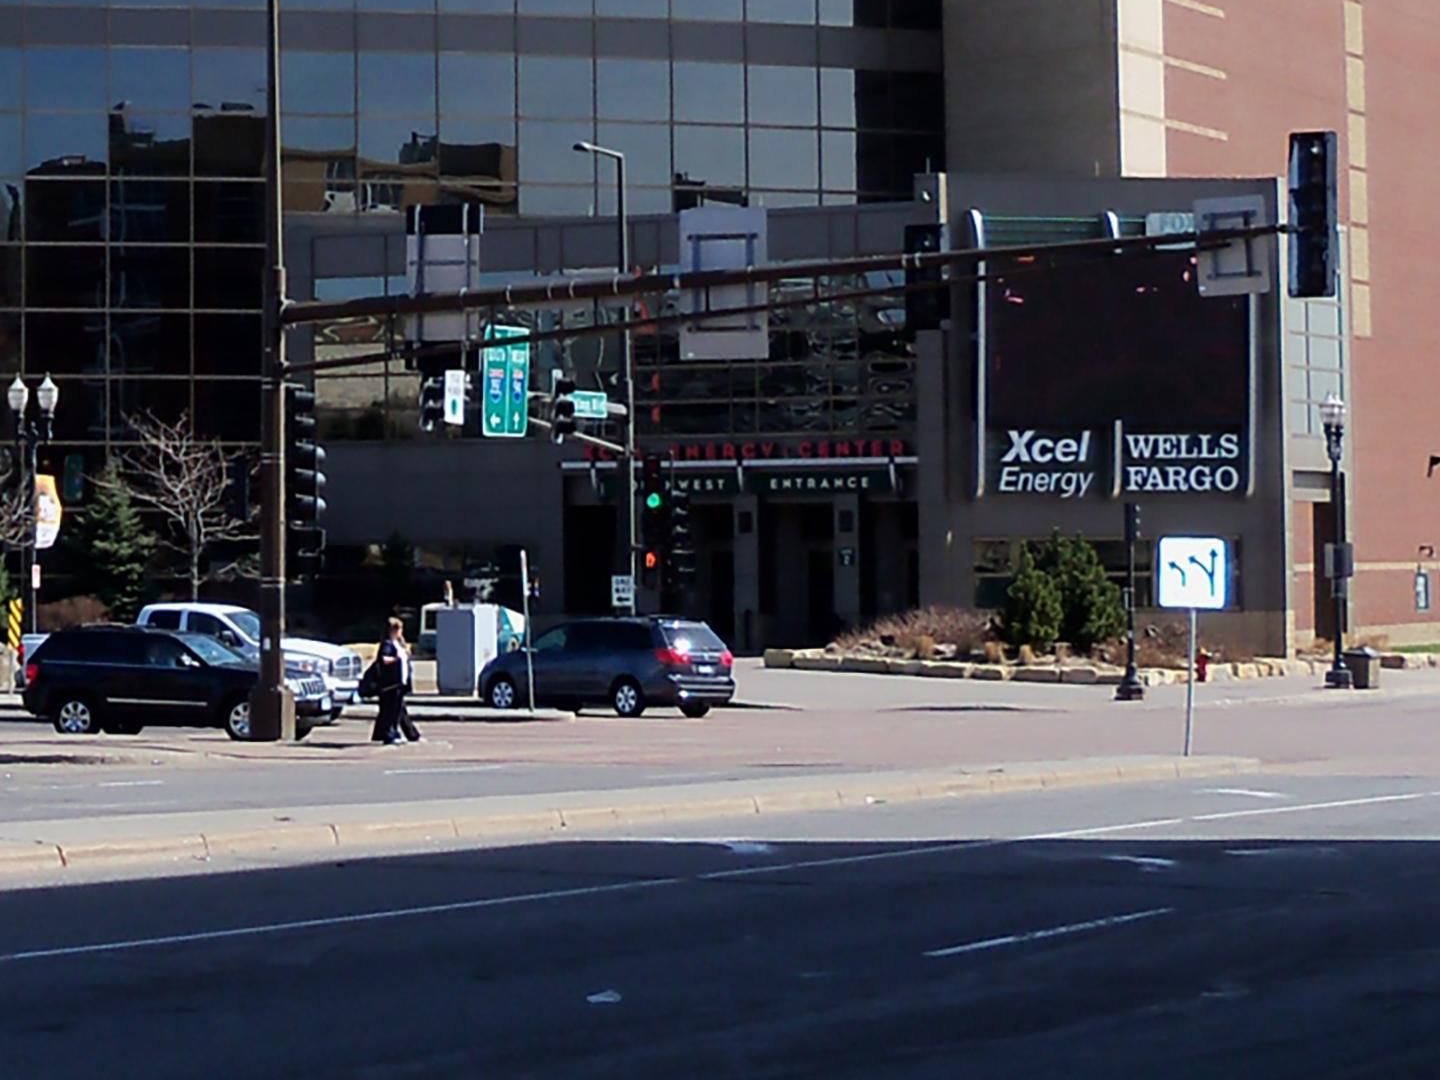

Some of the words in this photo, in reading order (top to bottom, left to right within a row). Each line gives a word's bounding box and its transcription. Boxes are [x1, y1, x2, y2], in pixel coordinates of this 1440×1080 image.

[799, 439, 903, 457] CENTER
[1001, 430, 1091, 463] Xcel
[1126, 434, 1239, 458] WELLS
[770, 476, 869, 489] ENTRANCE
[999, 466, 1094, 498] Energy
[1126, 466, 1239, 491] FARGO
